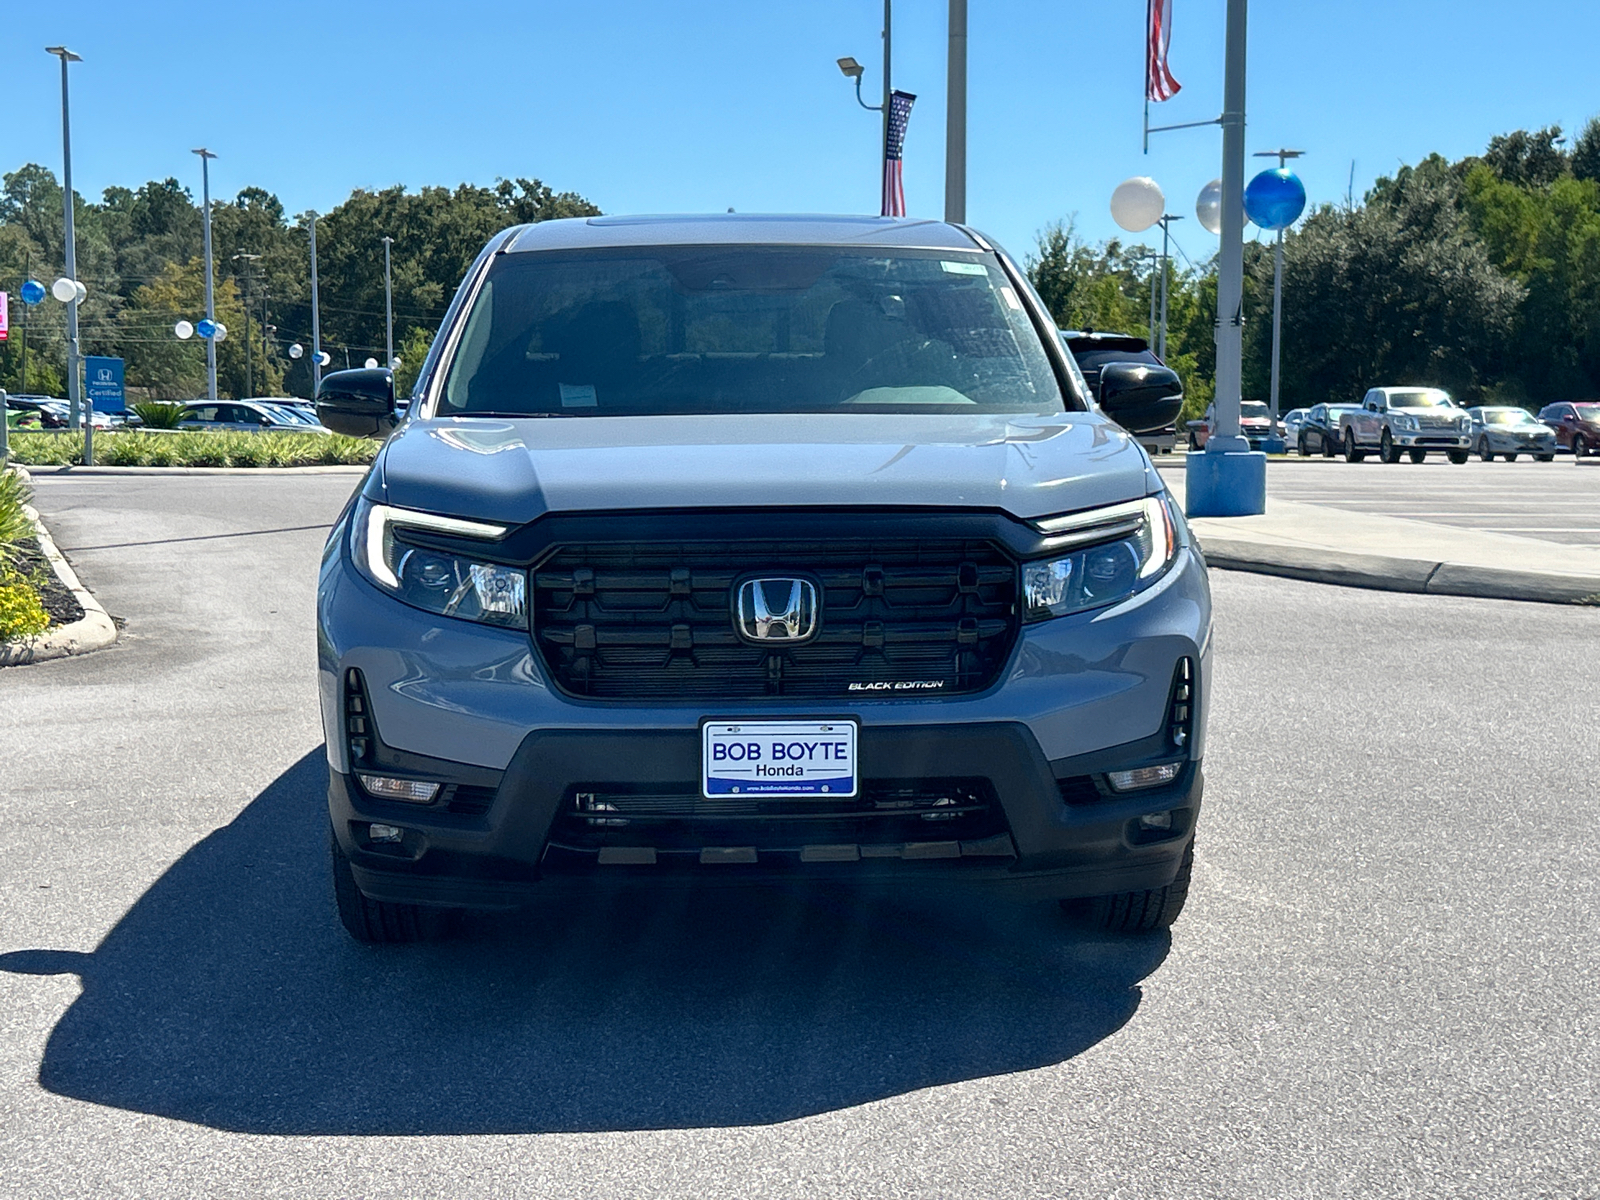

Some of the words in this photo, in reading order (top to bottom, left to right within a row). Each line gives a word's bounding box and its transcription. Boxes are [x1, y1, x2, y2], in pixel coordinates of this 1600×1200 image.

[848, 682, 891, 690] BLACK
[894, 680, 944, 690] EDITION
[713, 742, 762, 760] BOB
[772, 742, 848, 760] BOYTE
[756, 764, 804, 776] Honda
